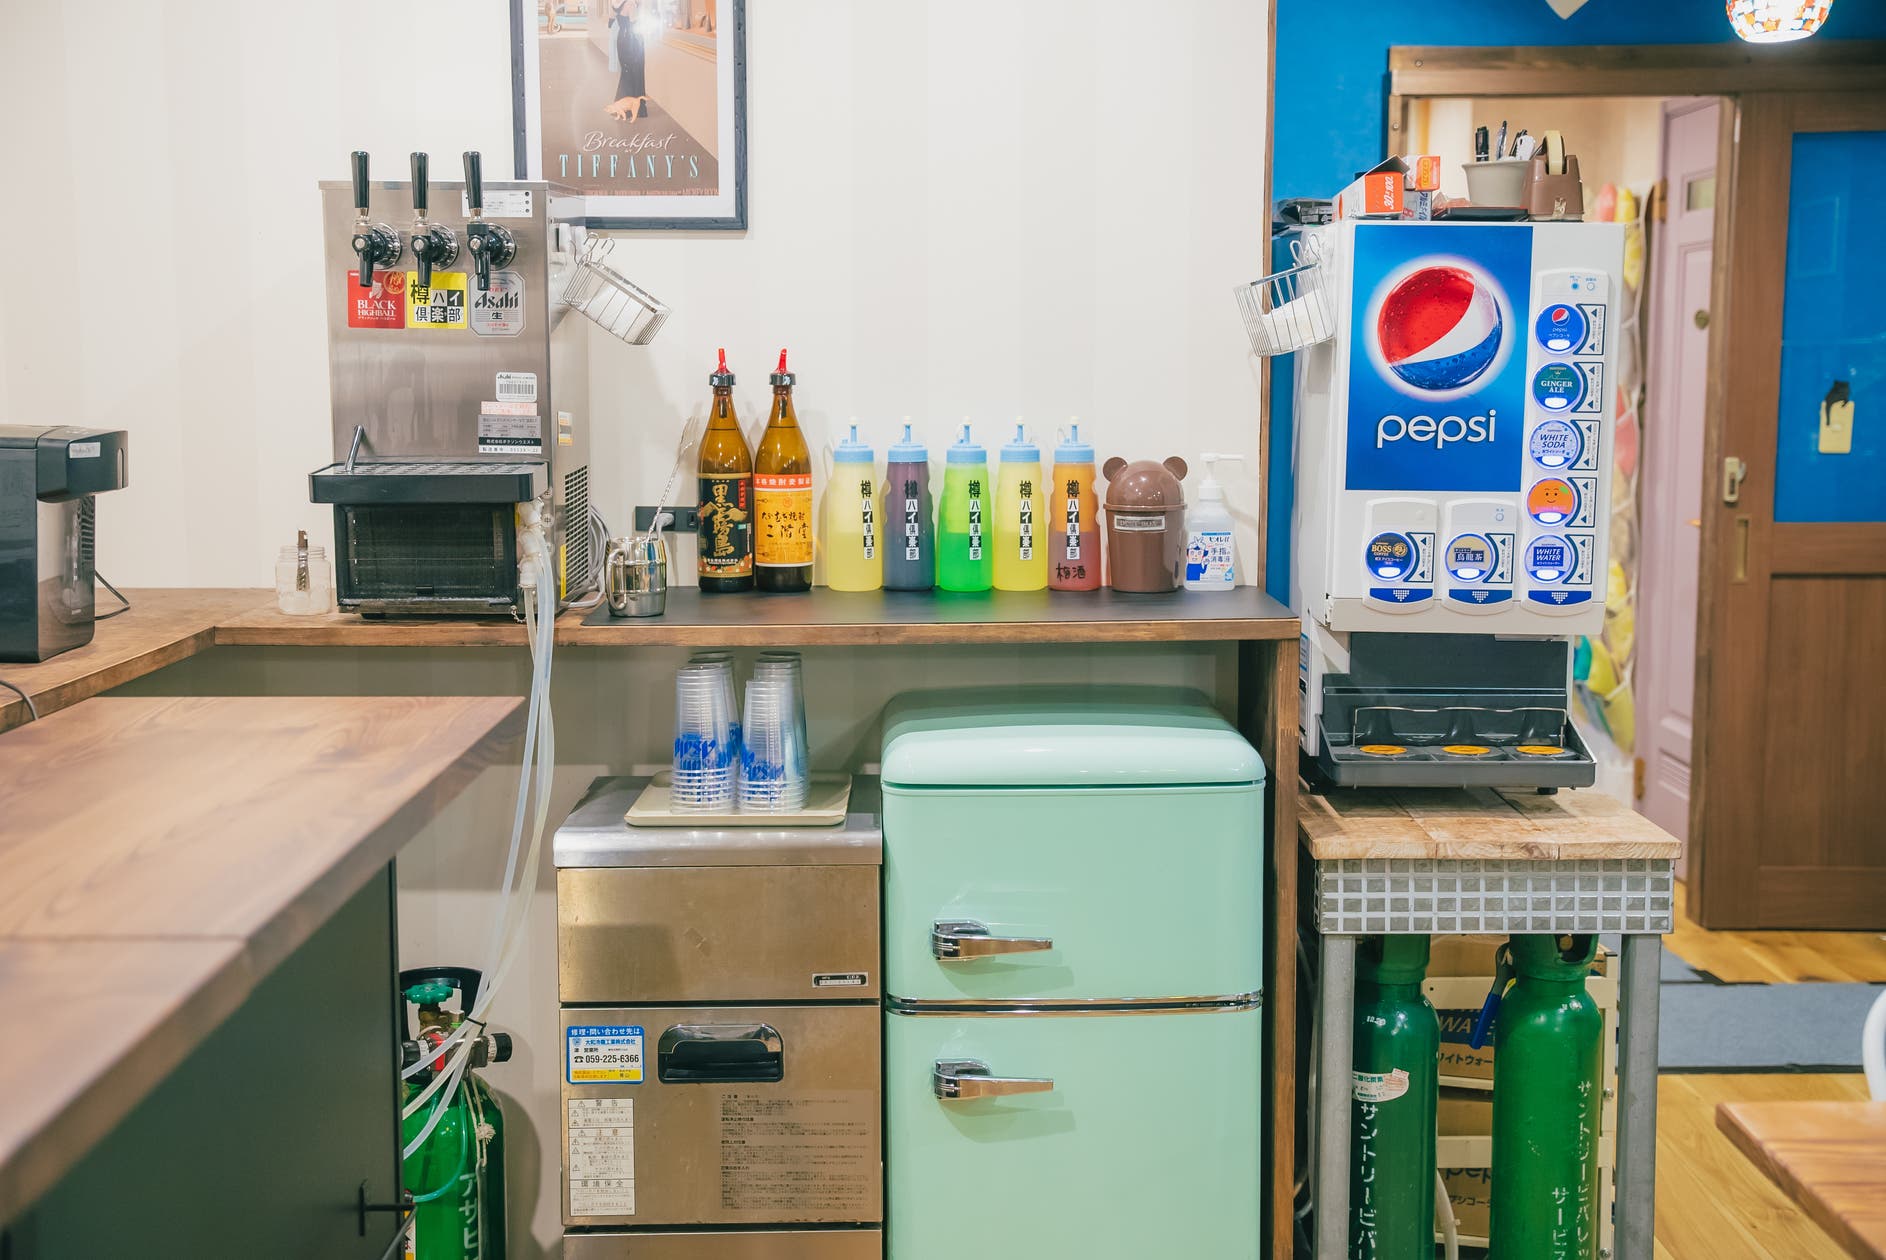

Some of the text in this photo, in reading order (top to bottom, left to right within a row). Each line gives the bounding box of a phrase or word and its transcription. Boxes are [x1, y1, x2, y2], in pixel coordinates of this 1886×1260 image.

[584, 131, 677, 154] Breakfast
[559, 154, 699, 178] TIFFANY'S
[357, 300, 396, 309] BLACK
[475, 291, 519, 309] Asahi
[491, 312, 503, 320] 生
[1541, 380, 1573, 388] GINGER
[1376, 409, 1497, 449] pepsi
[1372, 544, 1391, 552] BOSS
[1056, 563, 1086, 581] 梅酒
[585, 1055, 640, 1063] 059-225-6366
